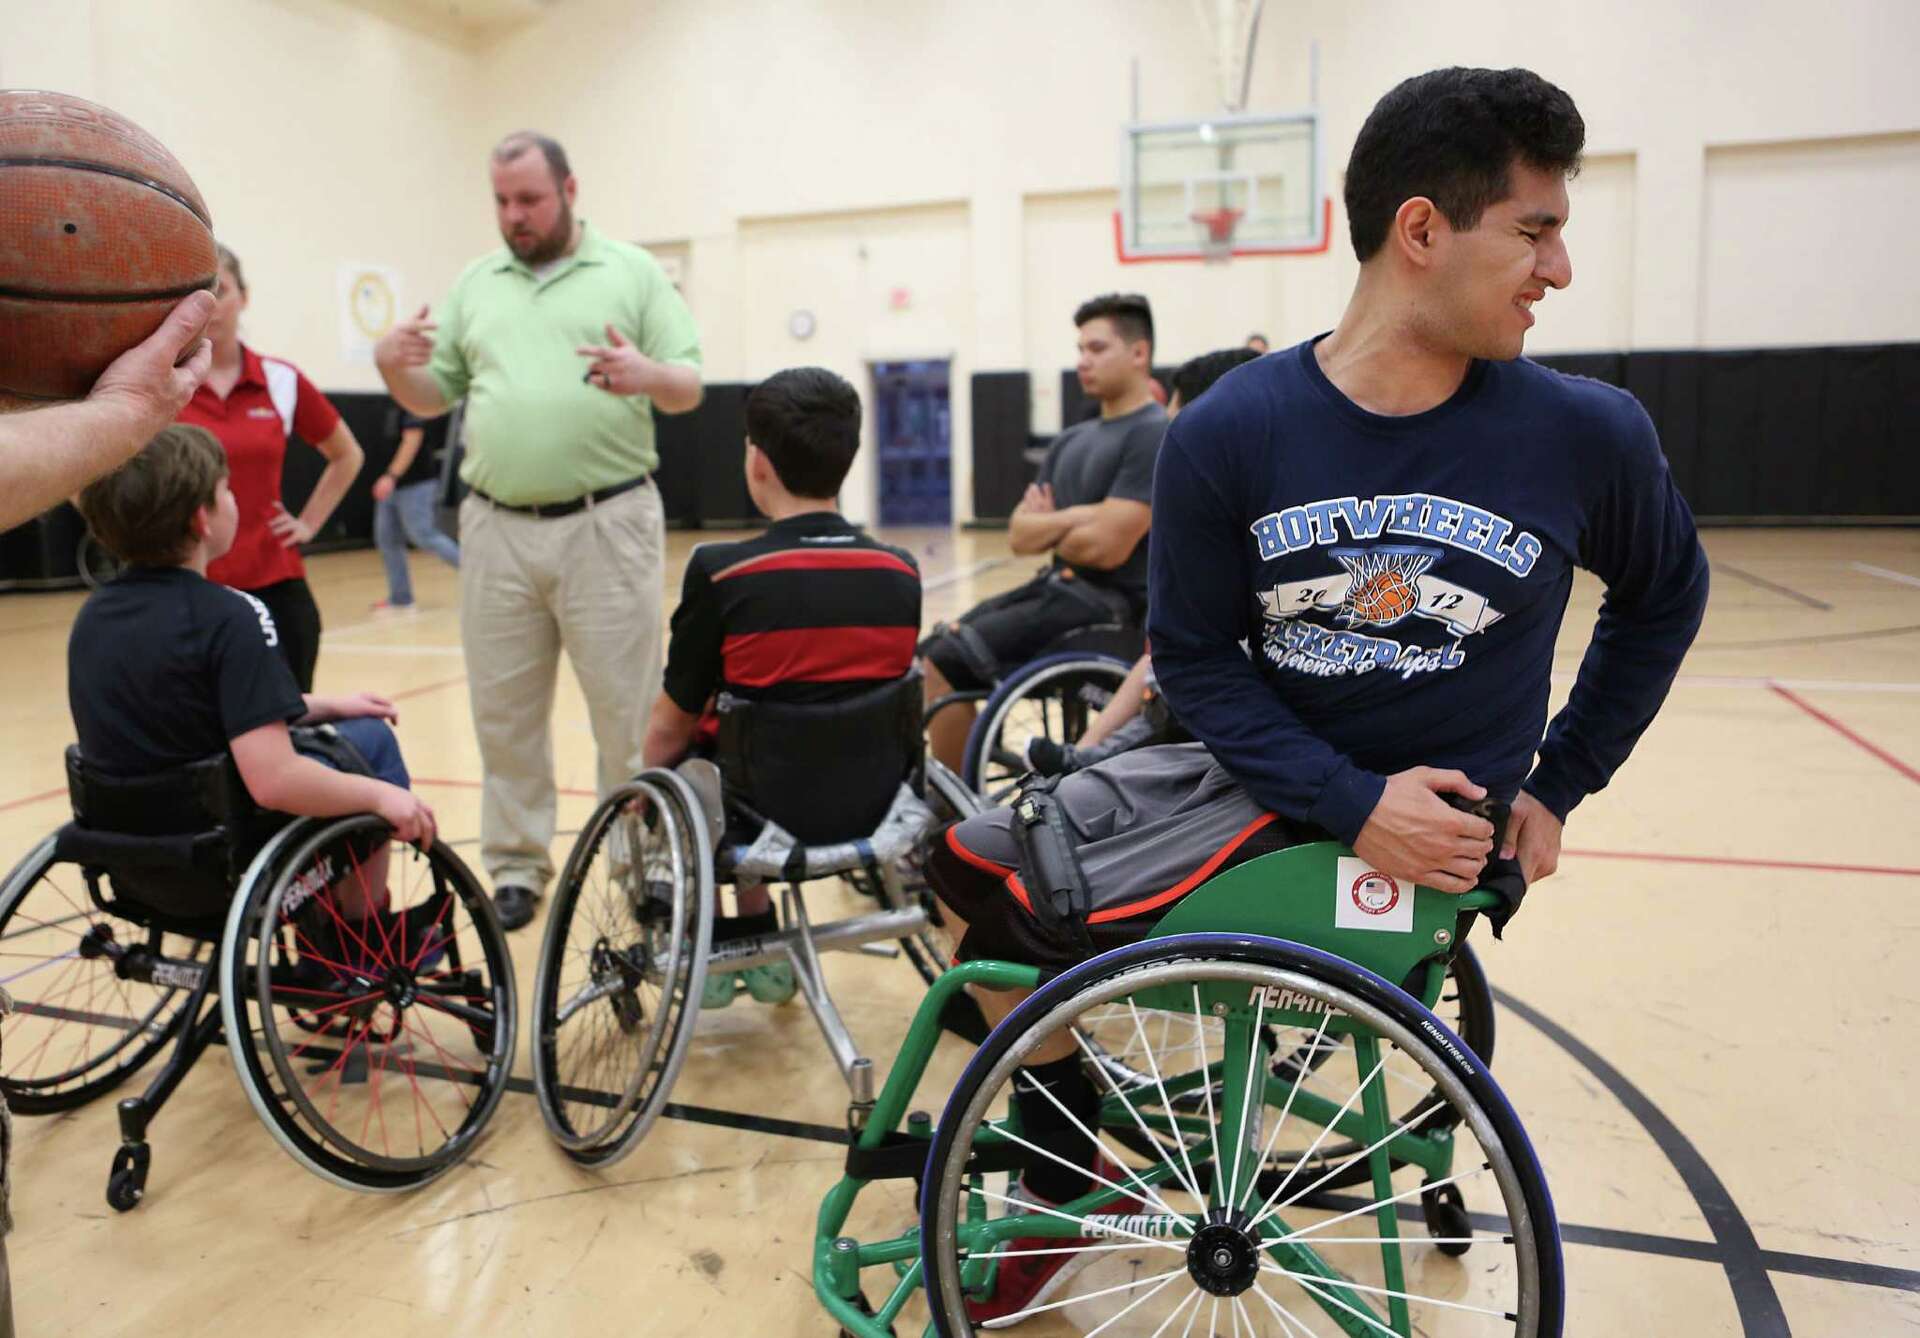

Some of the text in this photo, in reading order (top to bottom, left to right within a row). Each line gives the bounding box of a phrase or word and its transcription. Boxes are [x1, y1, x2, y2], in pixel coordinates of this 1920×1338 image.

[1250, 493, 1543, 578] HOTWHEELS
[1430, 592, 1464, 610] 12
[1263, 641, 1347, 677] onference
